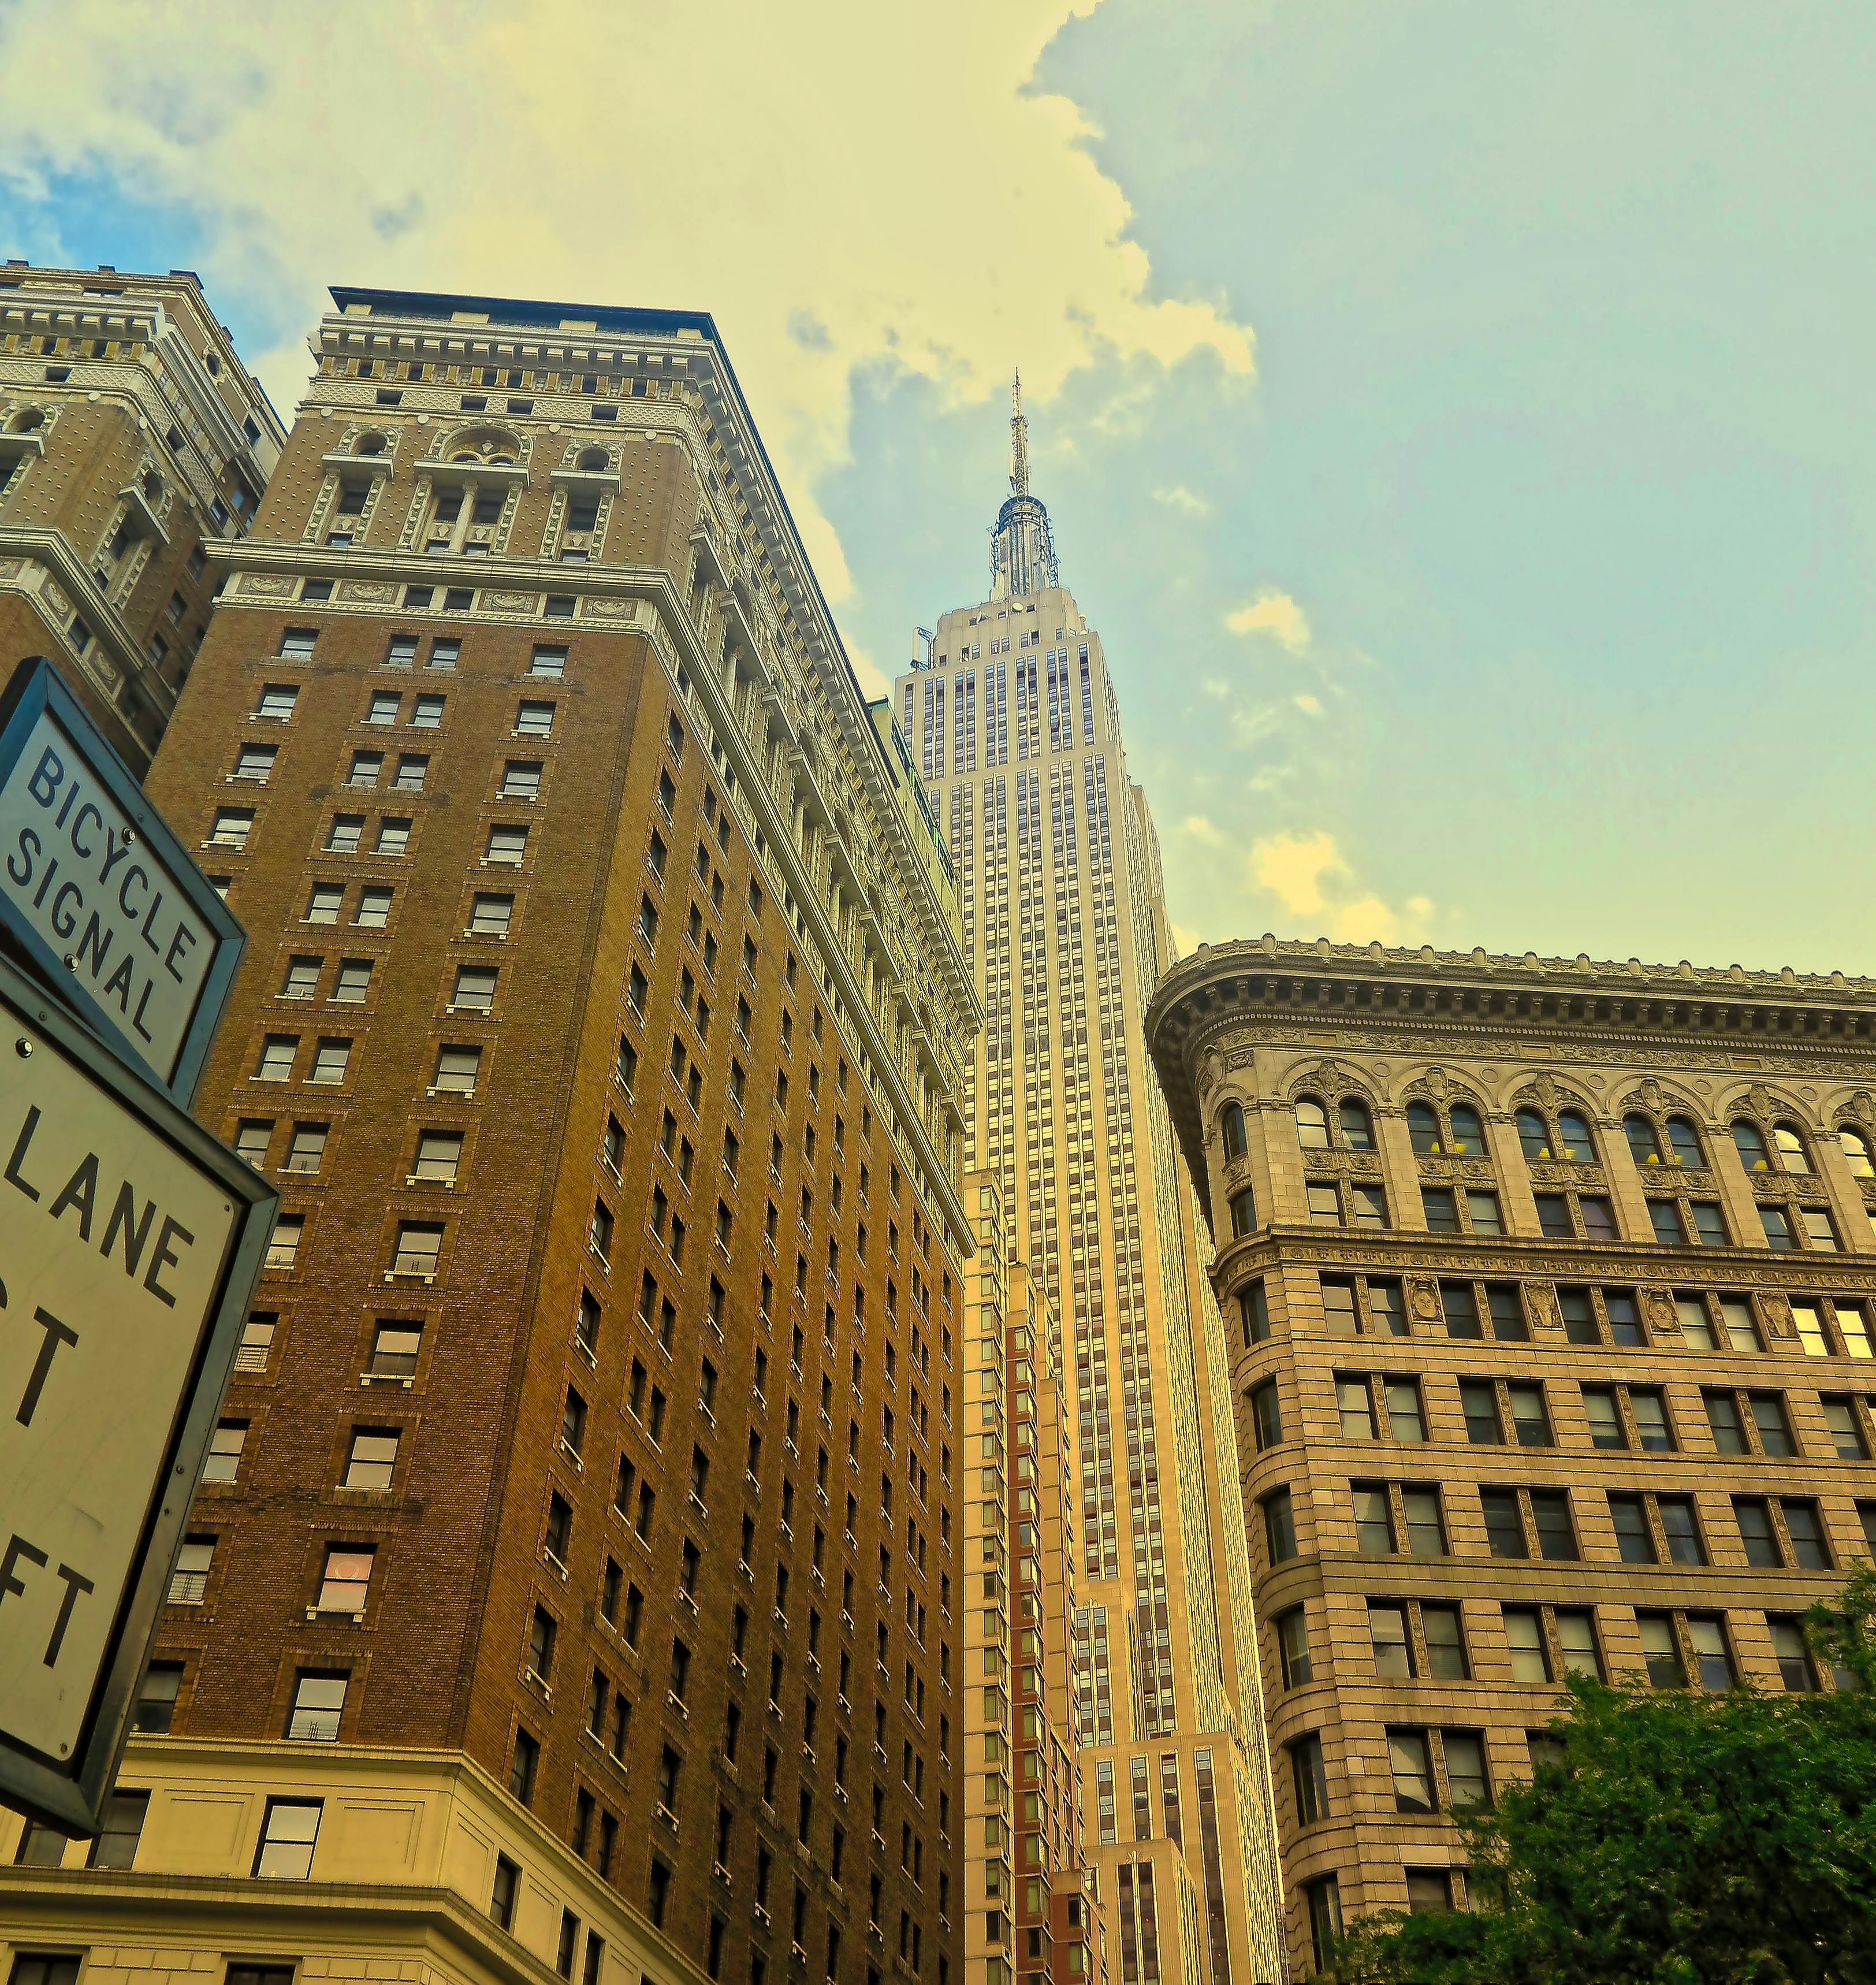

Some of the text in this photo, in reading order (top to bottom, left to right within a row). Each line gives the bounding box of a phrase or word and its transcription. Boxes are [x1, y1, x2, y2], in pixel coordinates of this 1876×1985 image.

[8, 827, 153, 1043] SIGNAL
[27, 745, 196, 984] BICYCLE
[3, 1104, 195, 1309] LANE
[0, 1276, 79, 1428] T
